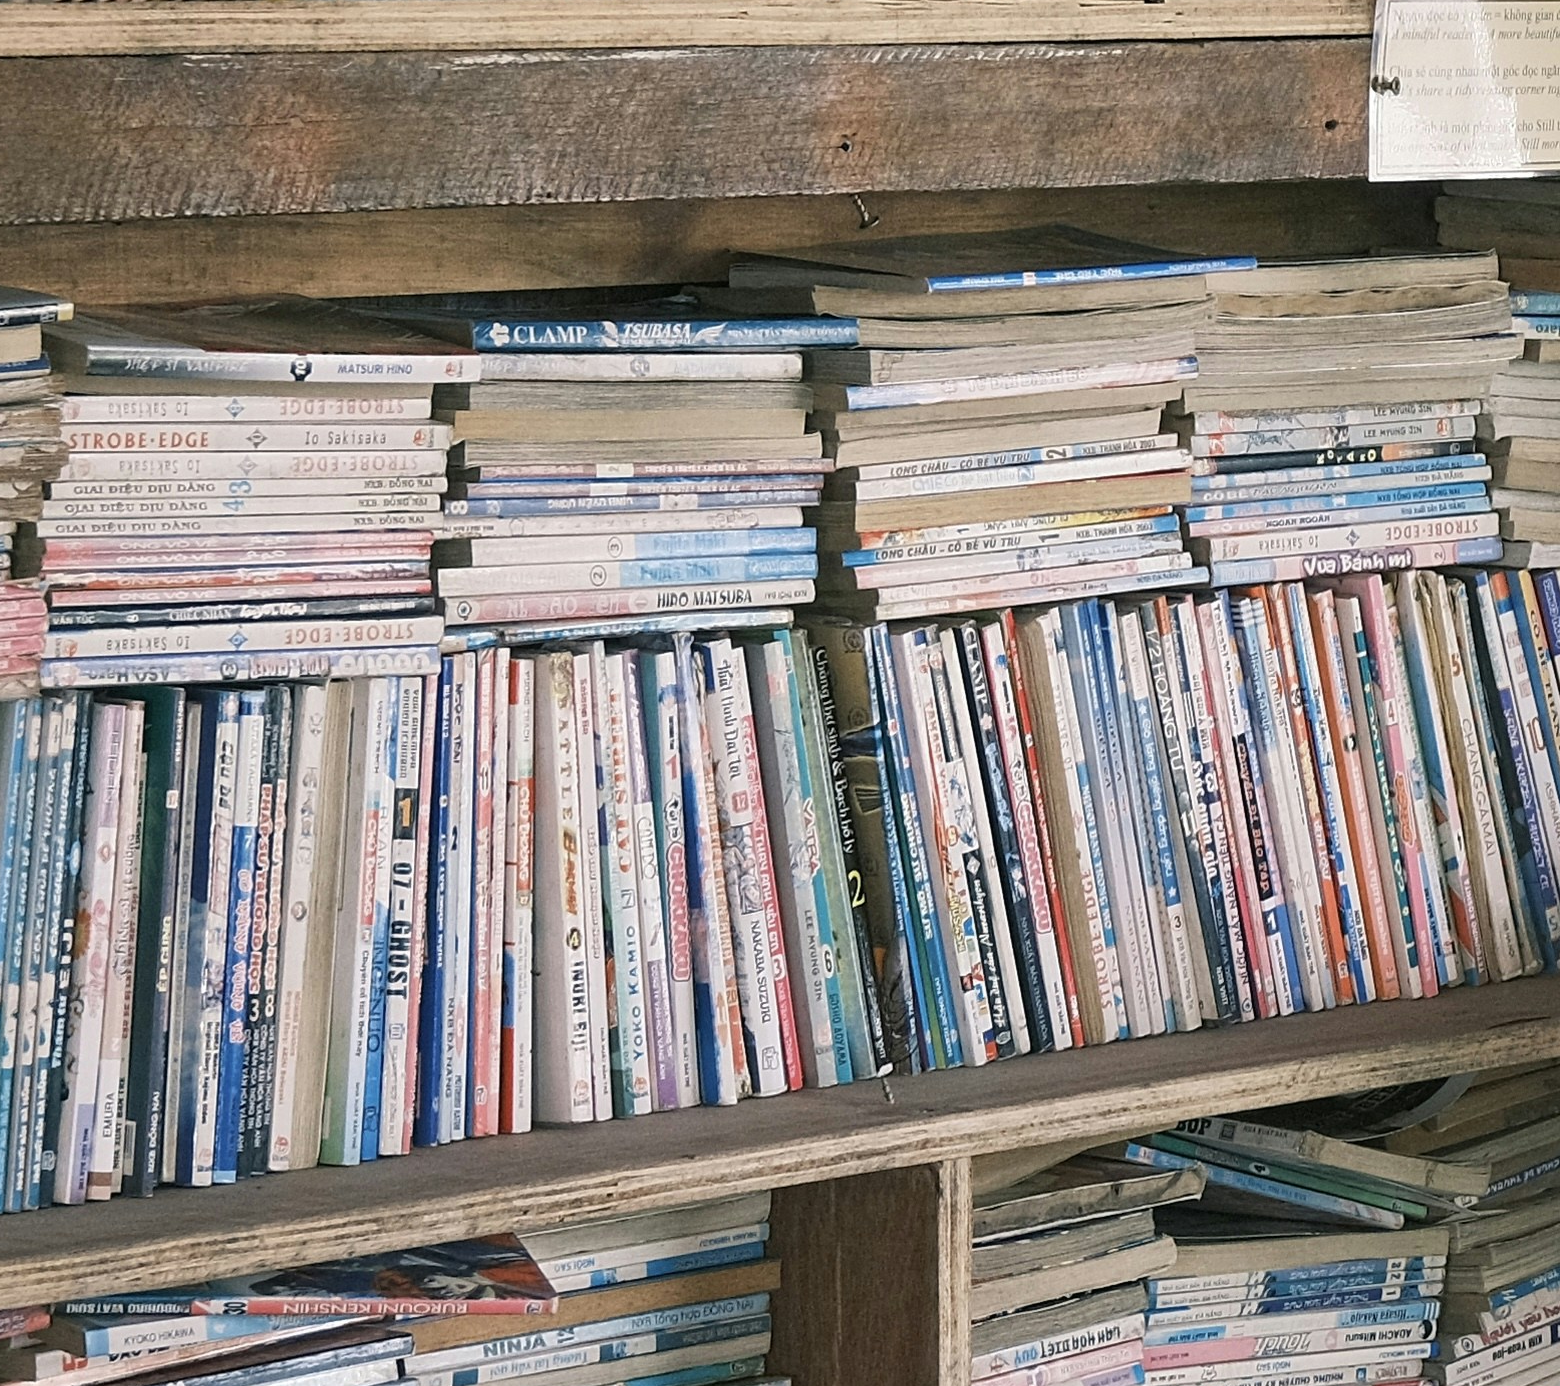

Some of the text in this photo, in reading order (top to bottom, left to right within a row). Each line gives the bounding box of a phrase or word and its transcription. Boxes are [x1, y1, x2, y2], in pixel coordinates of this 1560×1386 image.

[1504, 8, 1532, 25] không
[1535, 9, 1554, 26] gian
[1498, 30, 1522, 40] more
[1503, 66, 1520, 80] góc
[1522, 65, 1538, 79] đọc
[1515, 84, 1546, 95] corner
[1517, 119, 1534, 132] cho
[1536, 119, 1555, 132] Still
[1522, 137, 1540, 150] Still
[513, 322, 692, 345] CLAMP TSUBASA
[337, 363, 413, 375] MATSURI HINO
[304, 431, 318, 446] Io
[327, 429, 387, 445] Sakisaka
[874, 545, 906, 561] LONG
[907, 542, 937, 557] CHÂU
[948, 537, 964, 553] CÔ
[656, 589, 753, 609] HIRO MATSUBA
